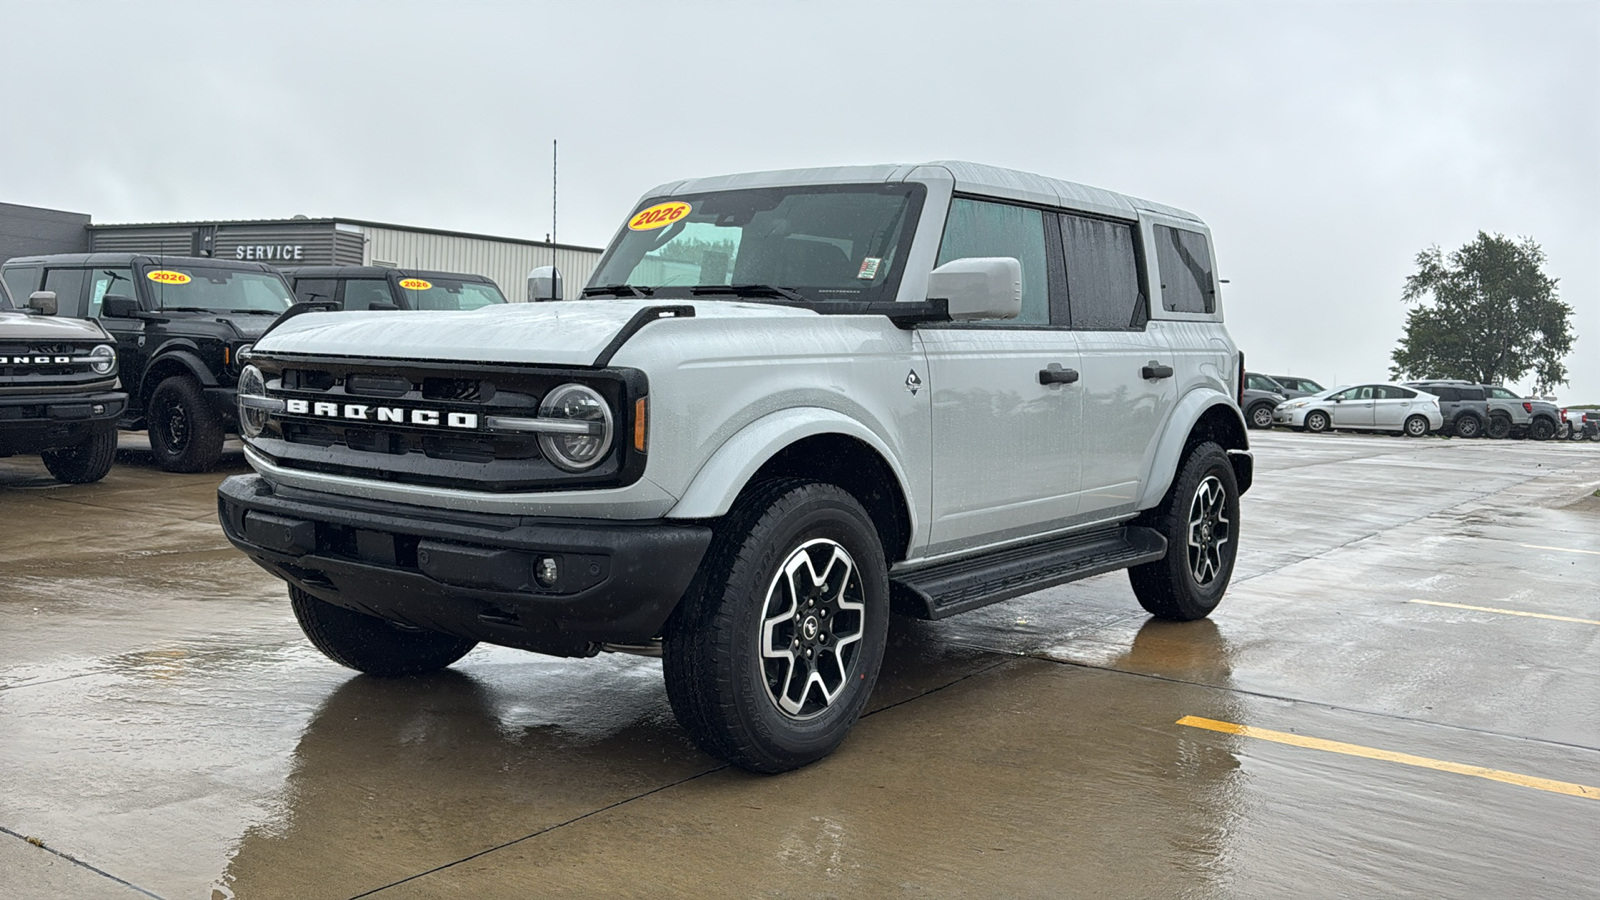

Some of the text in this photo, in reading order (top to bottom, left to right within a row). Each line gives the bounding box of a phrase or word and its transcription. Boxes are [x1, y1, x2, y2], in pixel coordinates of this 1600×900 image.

[632, 206, 686, 227] 2026
[236, 245, 304, 260] SERVICE
[153, 272, 186, 282] 2026
[403, 280, 429, 288] 2026
[286, 399, 478, 429] BRONCO
